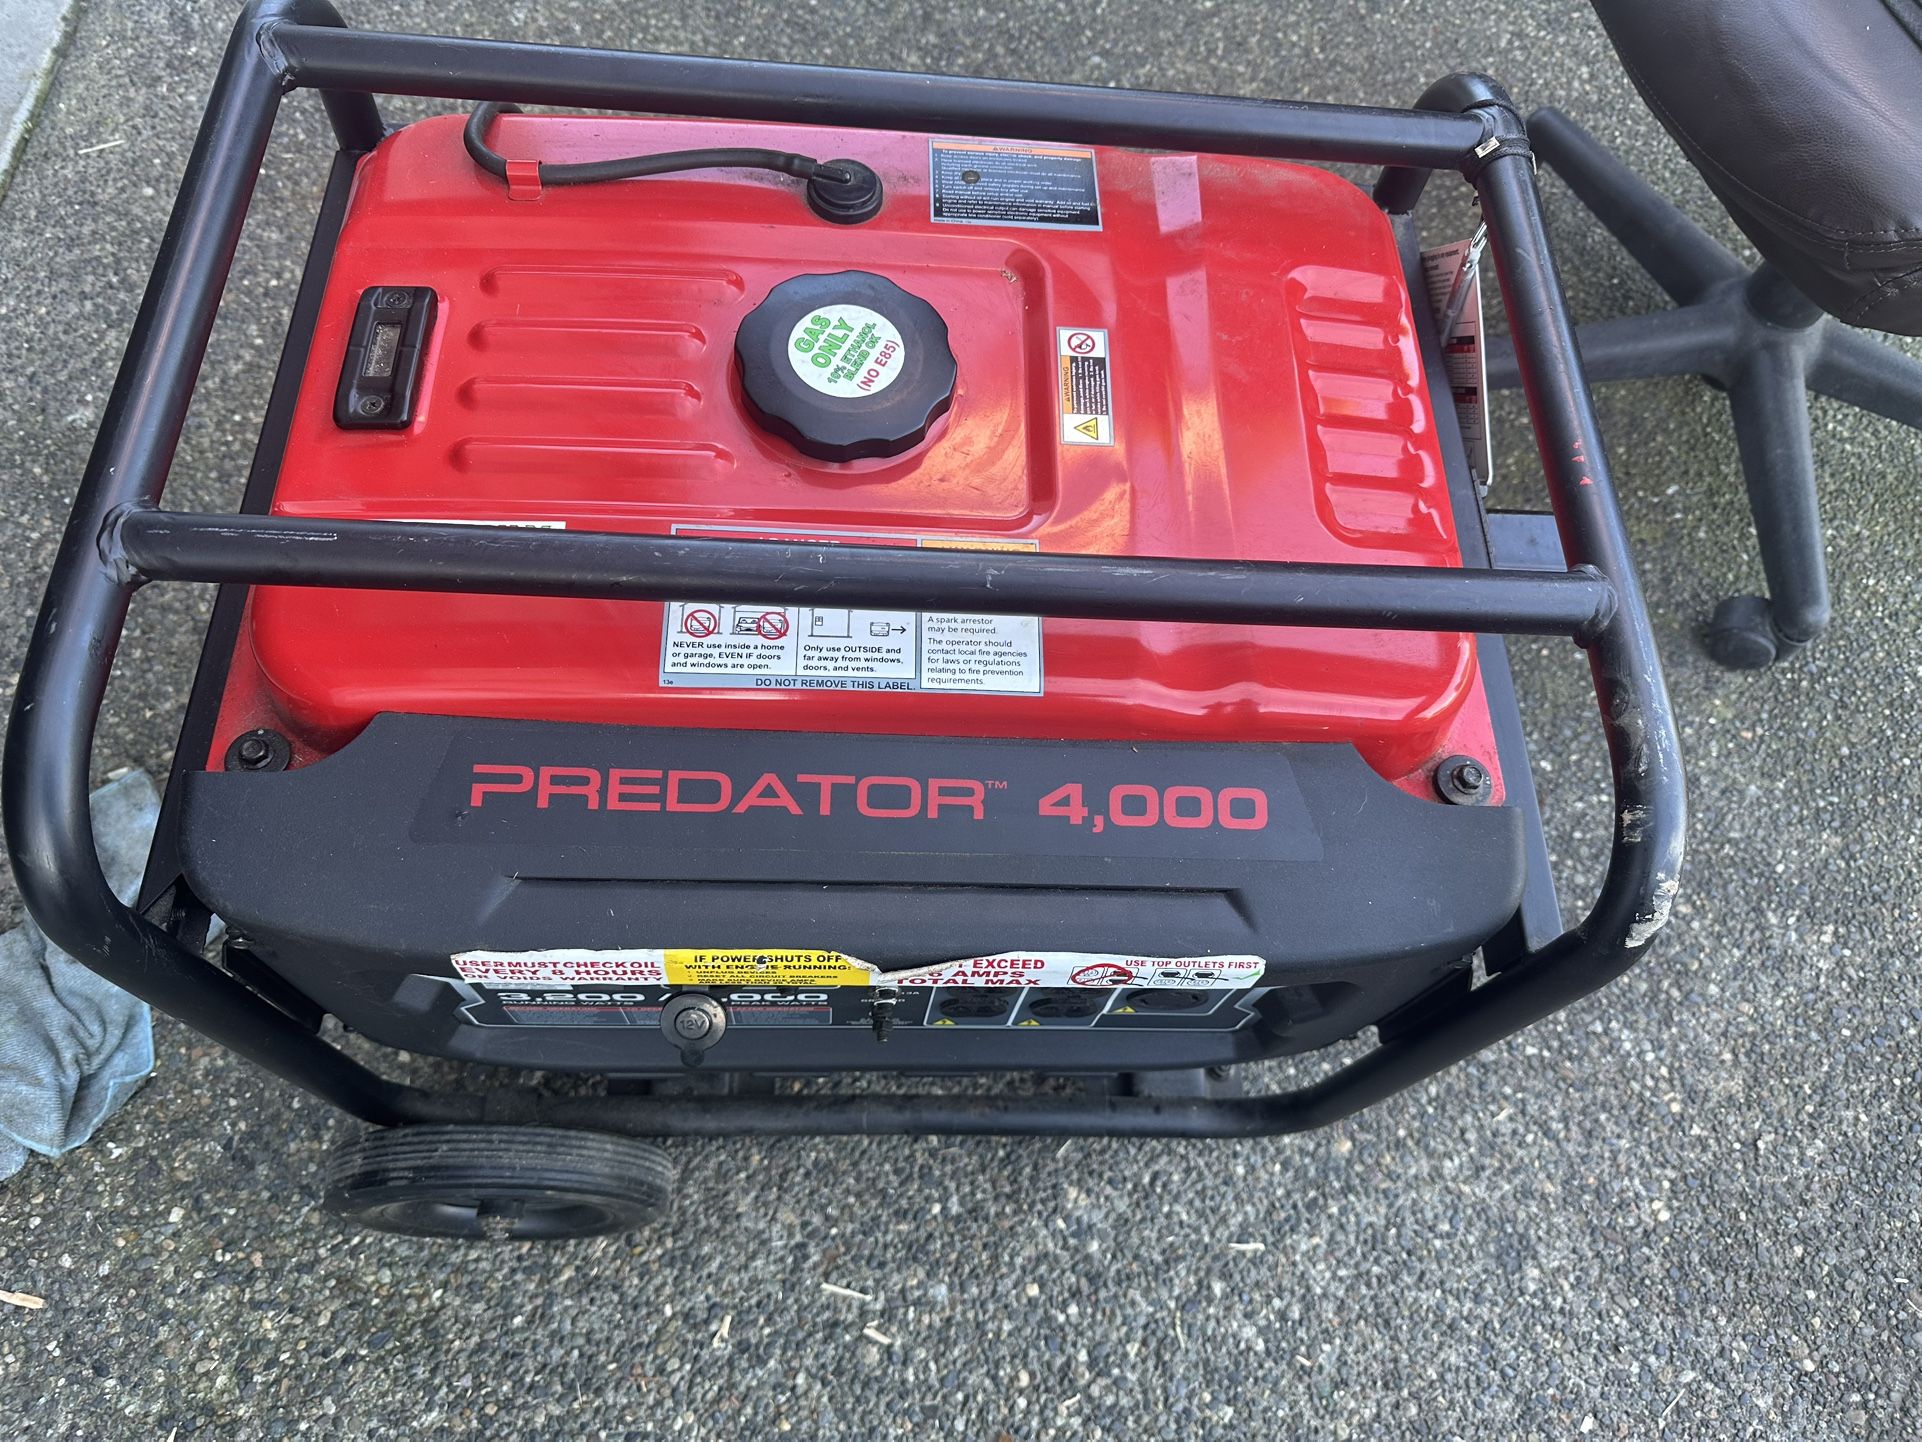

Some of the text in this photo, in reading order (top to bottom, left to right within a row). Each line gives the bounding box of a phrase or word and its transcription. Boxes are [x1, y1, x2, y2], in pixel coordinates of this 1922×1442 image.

[794, 314, 831, 353] GAS
[811, 316, 855, 368] ONLY
[840, 322, 877, 365] ETHANOL
[842, 333, 882, 382] BLEND OK
[856, 340, 900, 392] (NO E85)
[804, 644, 823, 653] Only
[974, 659, 1021, 668] regulations
[927, 667, 956, 675] relating
[756, 678, 916, 690] DO NOT REMOVE THIS LABEL.
[1039, 783, 1268, 833] 4,000
[972, 959, 1045, 970] EXCEED
[1228, 961, 1260, 969] FIRST
[459, 967, 540, 975] EVERY
[497, 992, 829, 1002] 3,200 ,000
[680, 1019, 706, 1030] 12V
